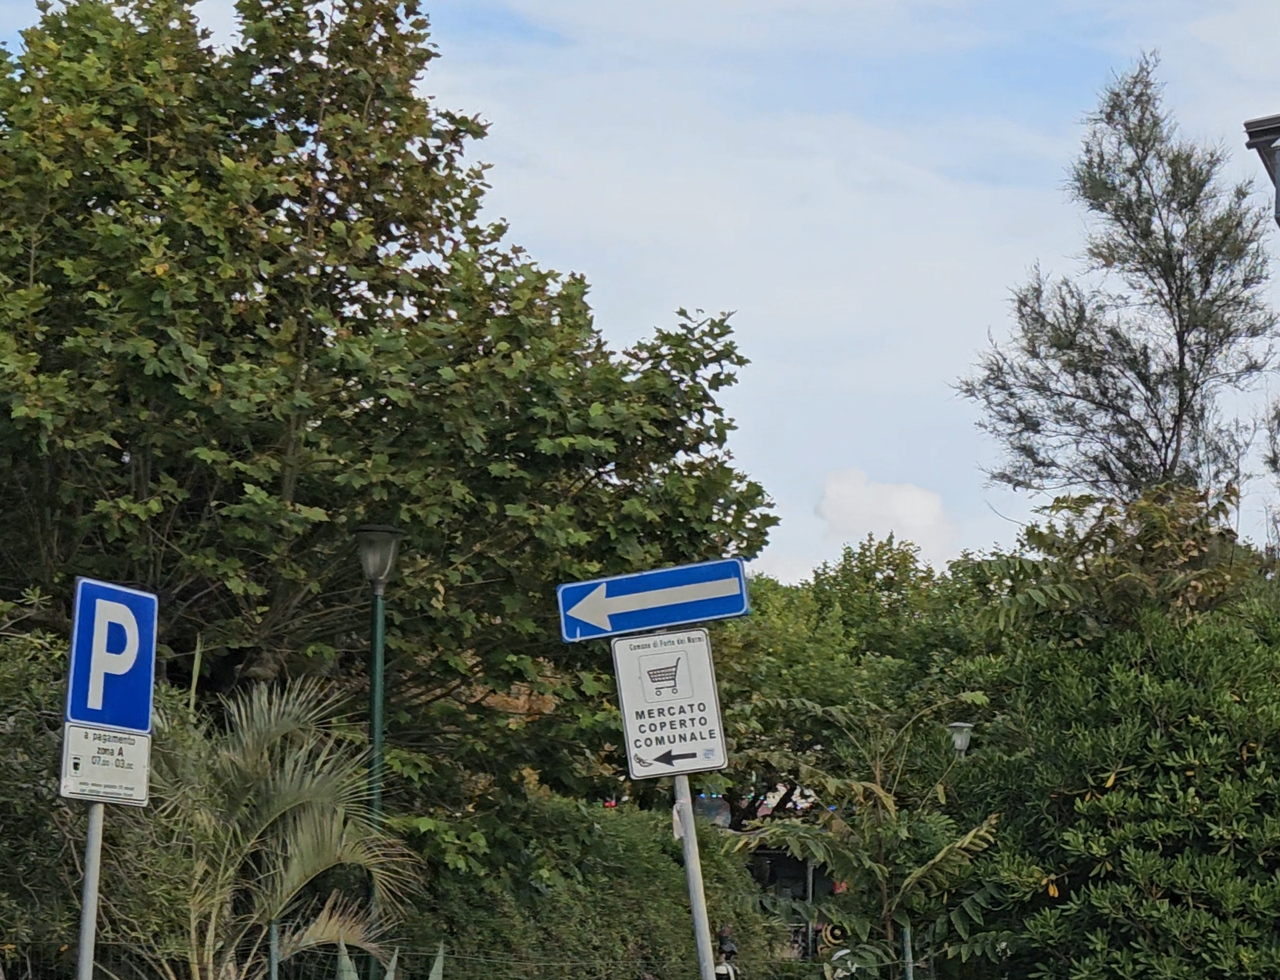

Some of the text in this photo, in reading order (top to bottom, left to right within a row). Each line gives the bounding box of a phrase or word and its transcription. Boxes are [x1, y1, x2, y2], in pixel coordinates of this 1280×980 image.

[87, 599, 139, 711] P
[628, 643, 651, 651] Comune
[635, 702, 707, 720] MERCATO
[638, 716, 708, 734] COPERTO
[634, 729, 717, 749] COMUNALE
